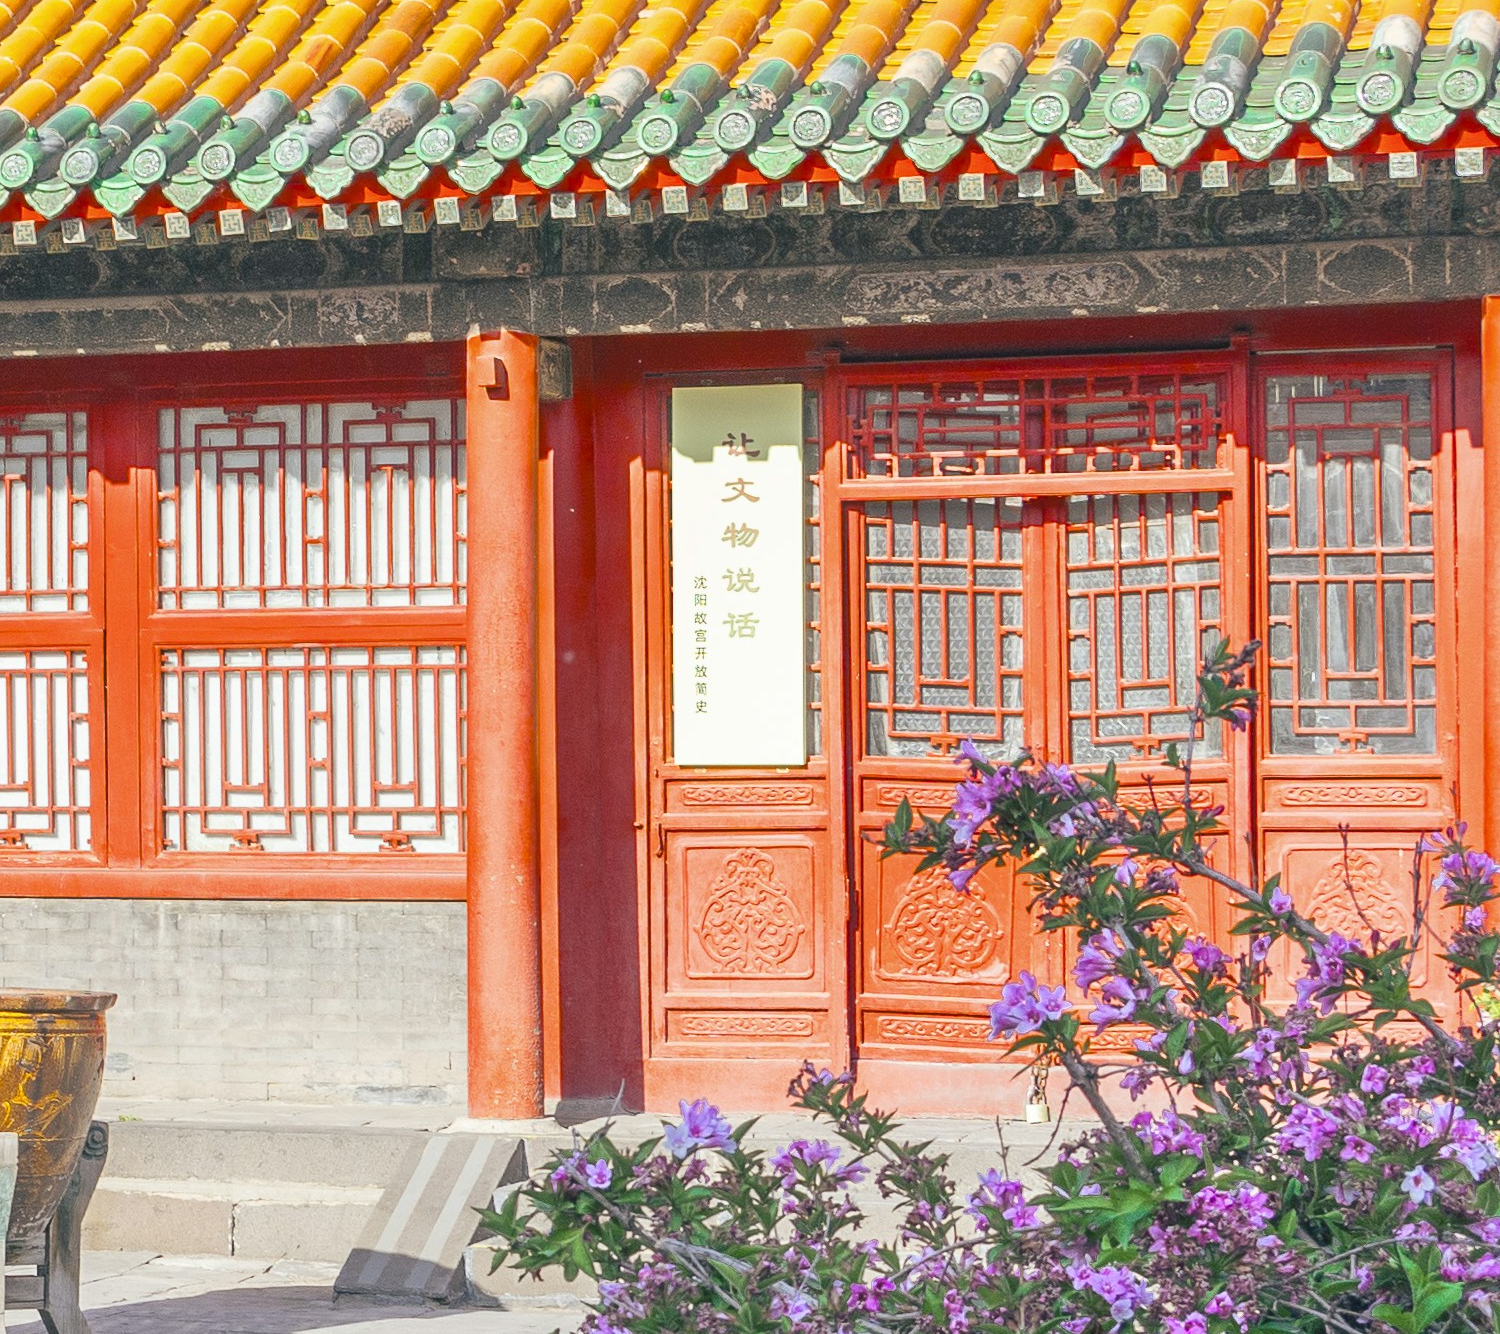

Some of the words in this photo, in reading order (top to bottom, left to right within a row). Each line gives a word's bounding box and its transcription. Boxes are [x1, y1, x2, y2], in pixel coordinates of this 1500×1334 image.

[721, 432, 761, 639] 让文物说话
[694, 575, 708, 713] 沈阳故宫开放简史
